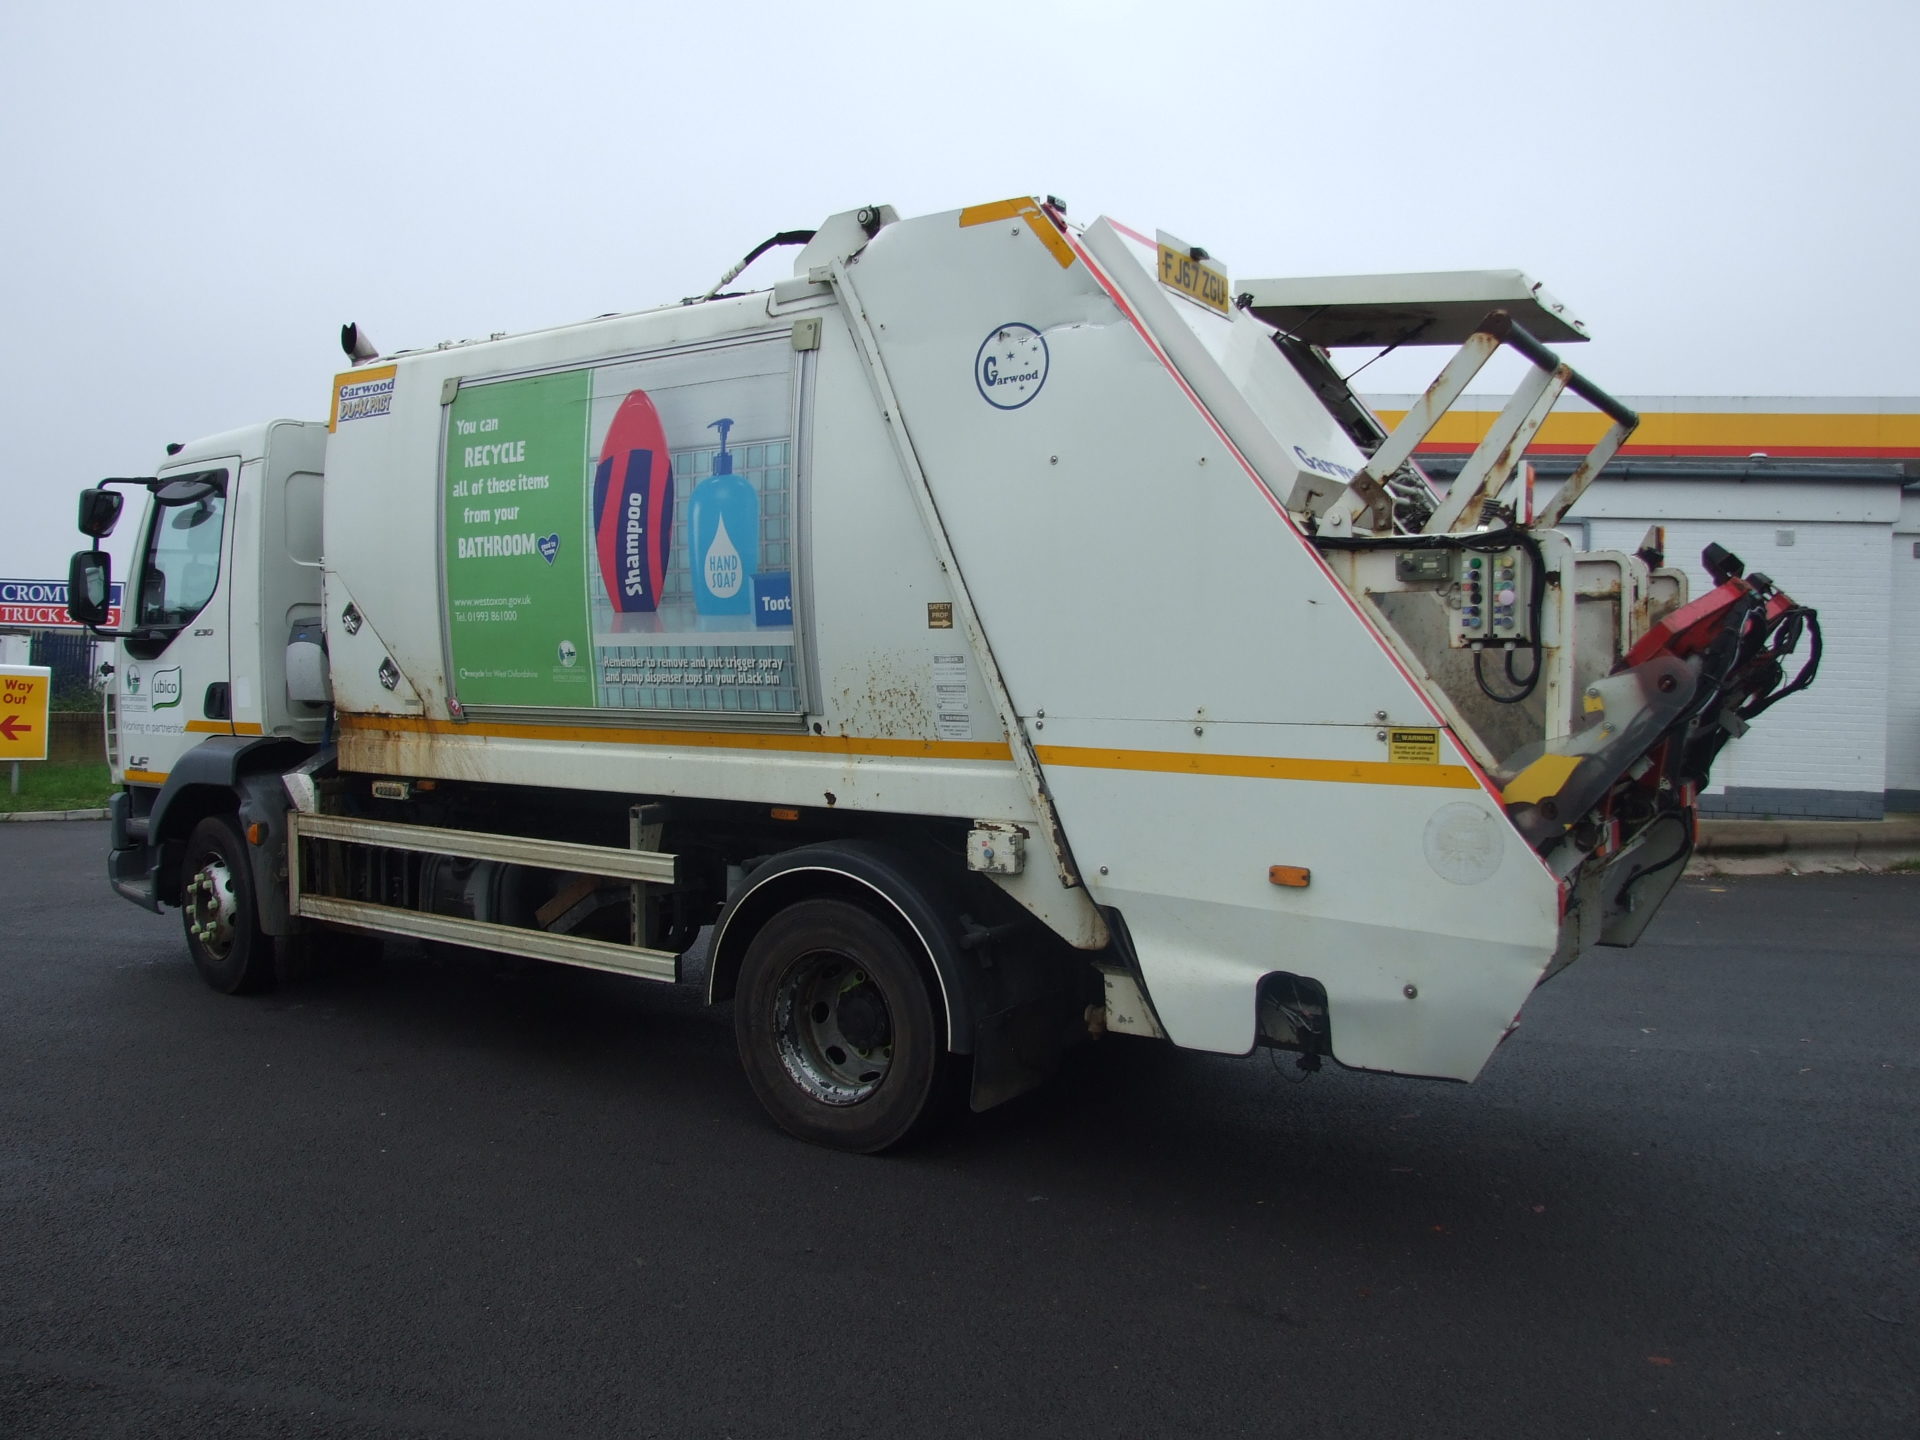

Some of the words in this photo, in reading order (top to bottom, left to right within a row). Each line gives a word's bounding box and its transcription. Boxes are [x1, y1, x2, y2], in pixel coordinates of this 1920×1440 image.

[1165, 252, 1200, 291] FJ67
[1202, 271, 1224, 305] ZGU
[983, 356, 1039, 386] Garwood
[340, 378, 395, 398] Garwood
[456, 420, 476, 435] You
[480, 418, 498, 432] can
[465, 440, 526, 468] RECYCLE
[453, 480, 468, 497] all
[471, 479, 483, 495] of
[487, 477, 516, 494] these
[518, 474, 549, 491] items
[464, 508, 490, 523] from
[494, 506, 519, 525] your
[458, 533, 535, 558] BATHROOM
[625, 492, 643, 597] Shampoo
[709, 554, 737, 572] HAND
[712, 571, 737, 589] SOAP
[762, 596, 792, 611] Toot
[2, 607, 59, 622] TRUCK
[467, 611, 489, 622] 01993
[491, 610, 517, 622] 861000
[194, 628, 214, 637] 230
[604, 656, 645, 668] Remember
[646, 657, 656, 668] to
[657, 658, 689, 668] remove
[691, 656, 706, 668] and
[708, 657, 725, 670] put
[726, 656, 756, 672] trigger
[759, 658, 783, 672] spray
[5, 680, 34, 694] Way
[154, 680, 177, 694] ubico
[605, 672, 620, 683] and
[621, 673, 643, 685] pump
[646, 672, 683, 685] dispenser
[685, 672, 702, 685] tops
[705, 672, 713, 683] in
[716, 673, 737, 686] your
[738, 672, 762, 684] black
[765, 673, 780, 685] bin
[3, 693, 27, 705] Out
[130, 755, 149, 766] LF
